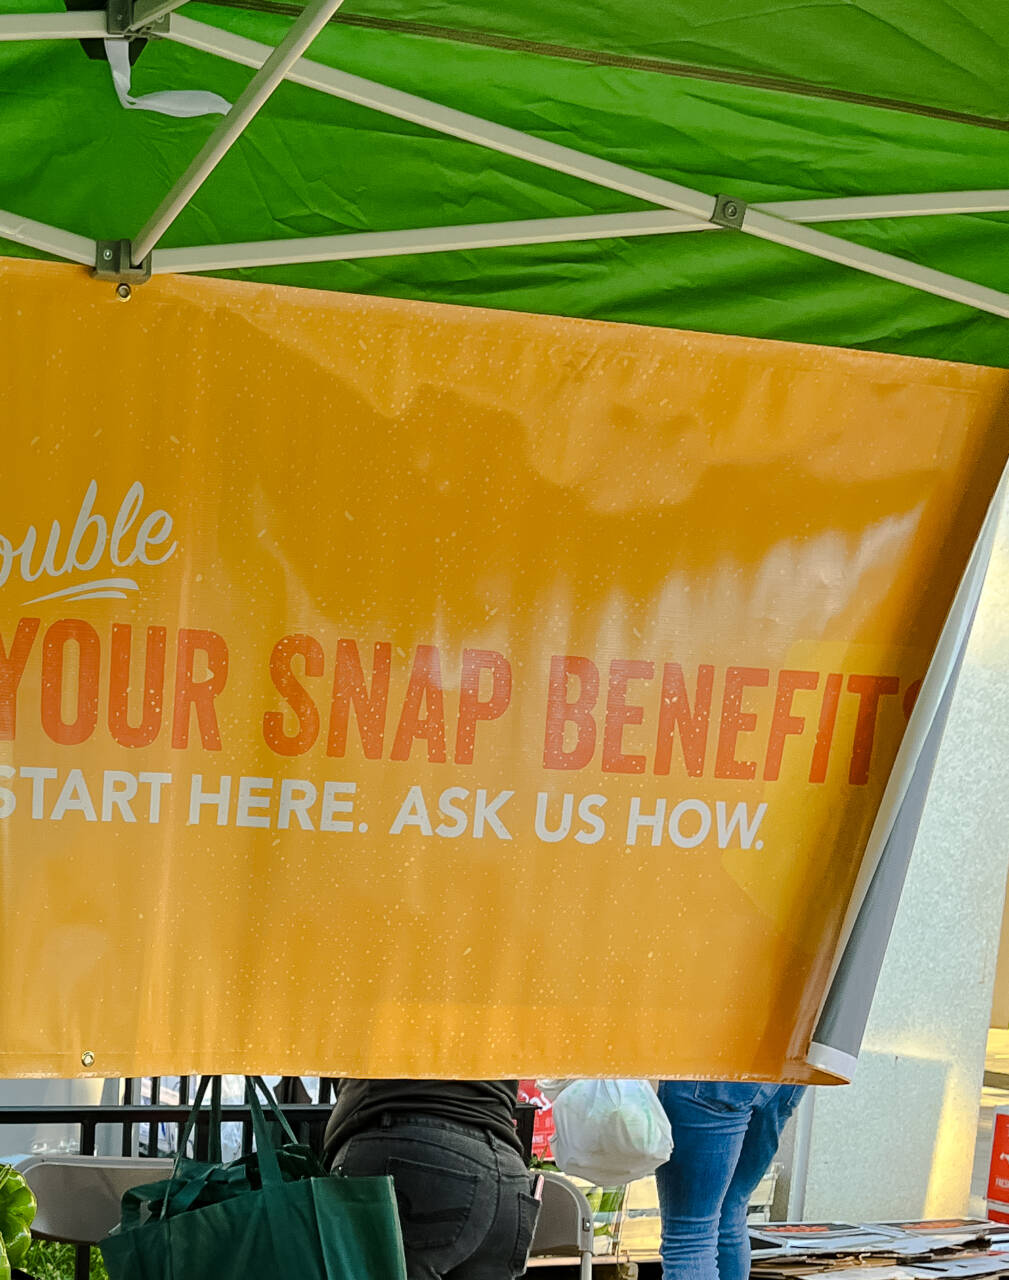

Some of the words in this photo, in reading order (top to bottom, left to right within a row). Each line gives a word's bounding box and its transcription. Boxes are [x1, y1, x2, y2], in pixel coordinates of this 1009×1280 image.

[262, 633, 512, 765] SNAP
[188, 774, 369, 833] HERE.
[389, 785, 516, 841] ASK
[534, 791, 608, 846] US
[625, 797, 768, 850] HOW.
